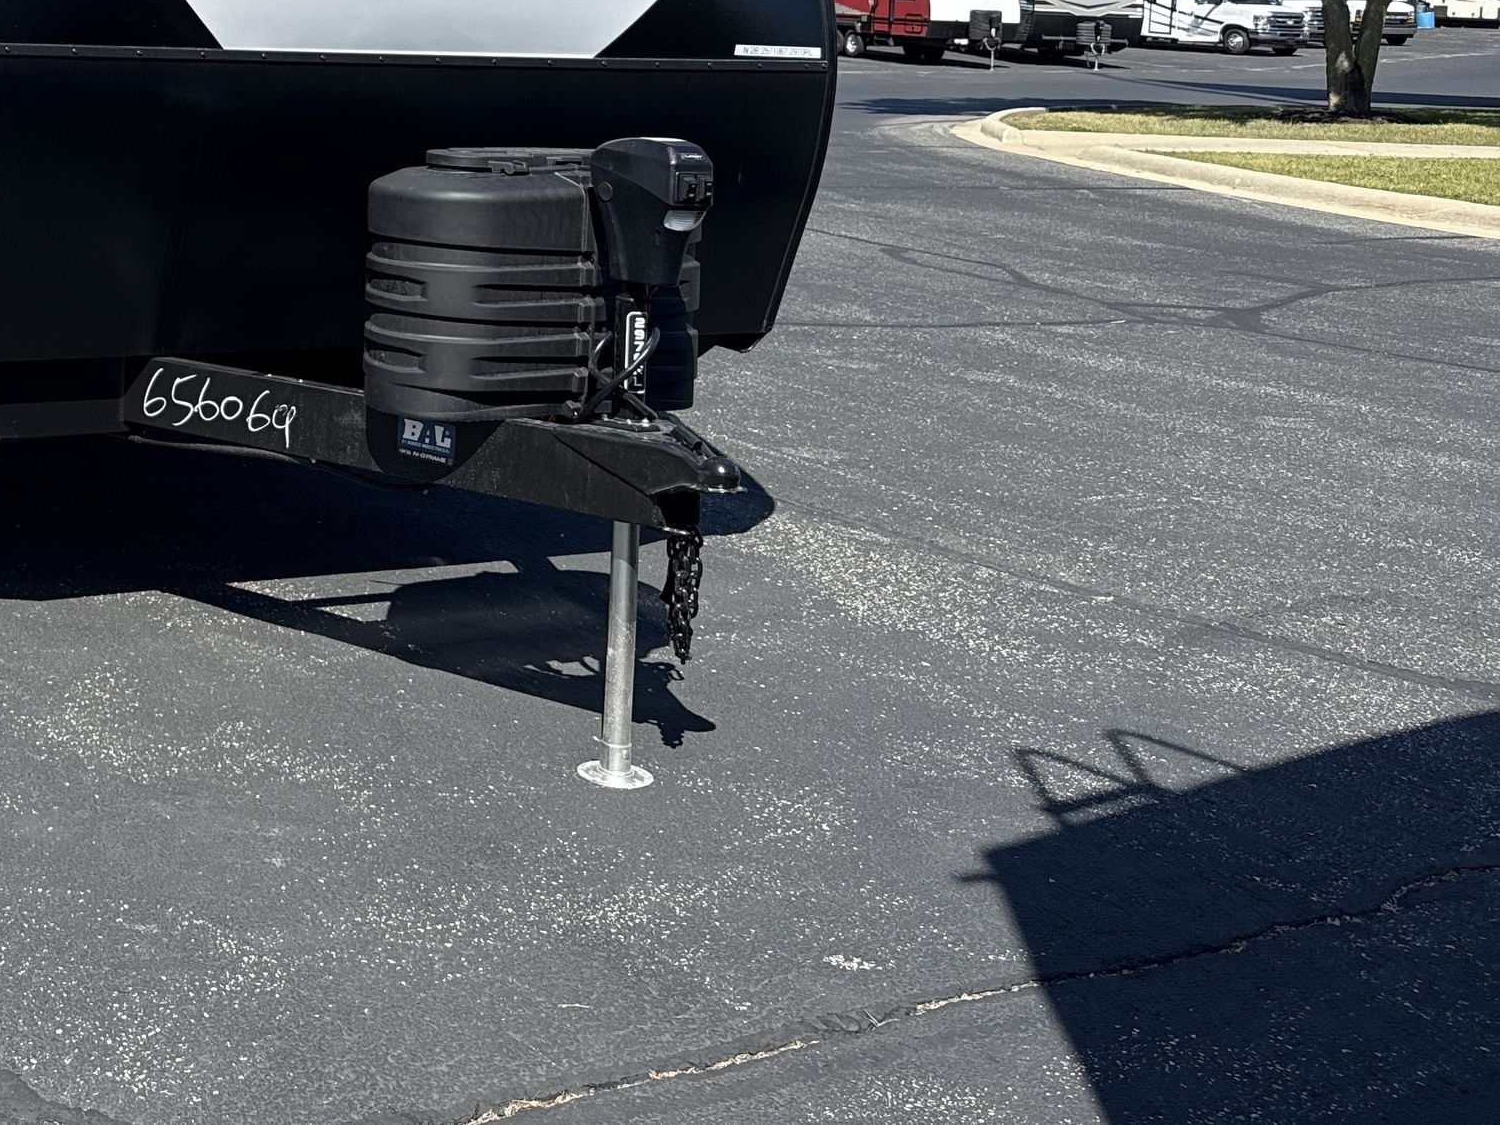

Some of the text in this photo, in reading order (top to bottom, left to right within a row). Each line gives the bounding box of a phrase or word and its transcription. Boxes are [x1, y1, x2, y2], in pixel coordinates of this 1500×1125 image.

[632, 317, 646, 387] 297L
[143, 367, 297, 449] 656069
[402, 418, 452, 449] BAL
